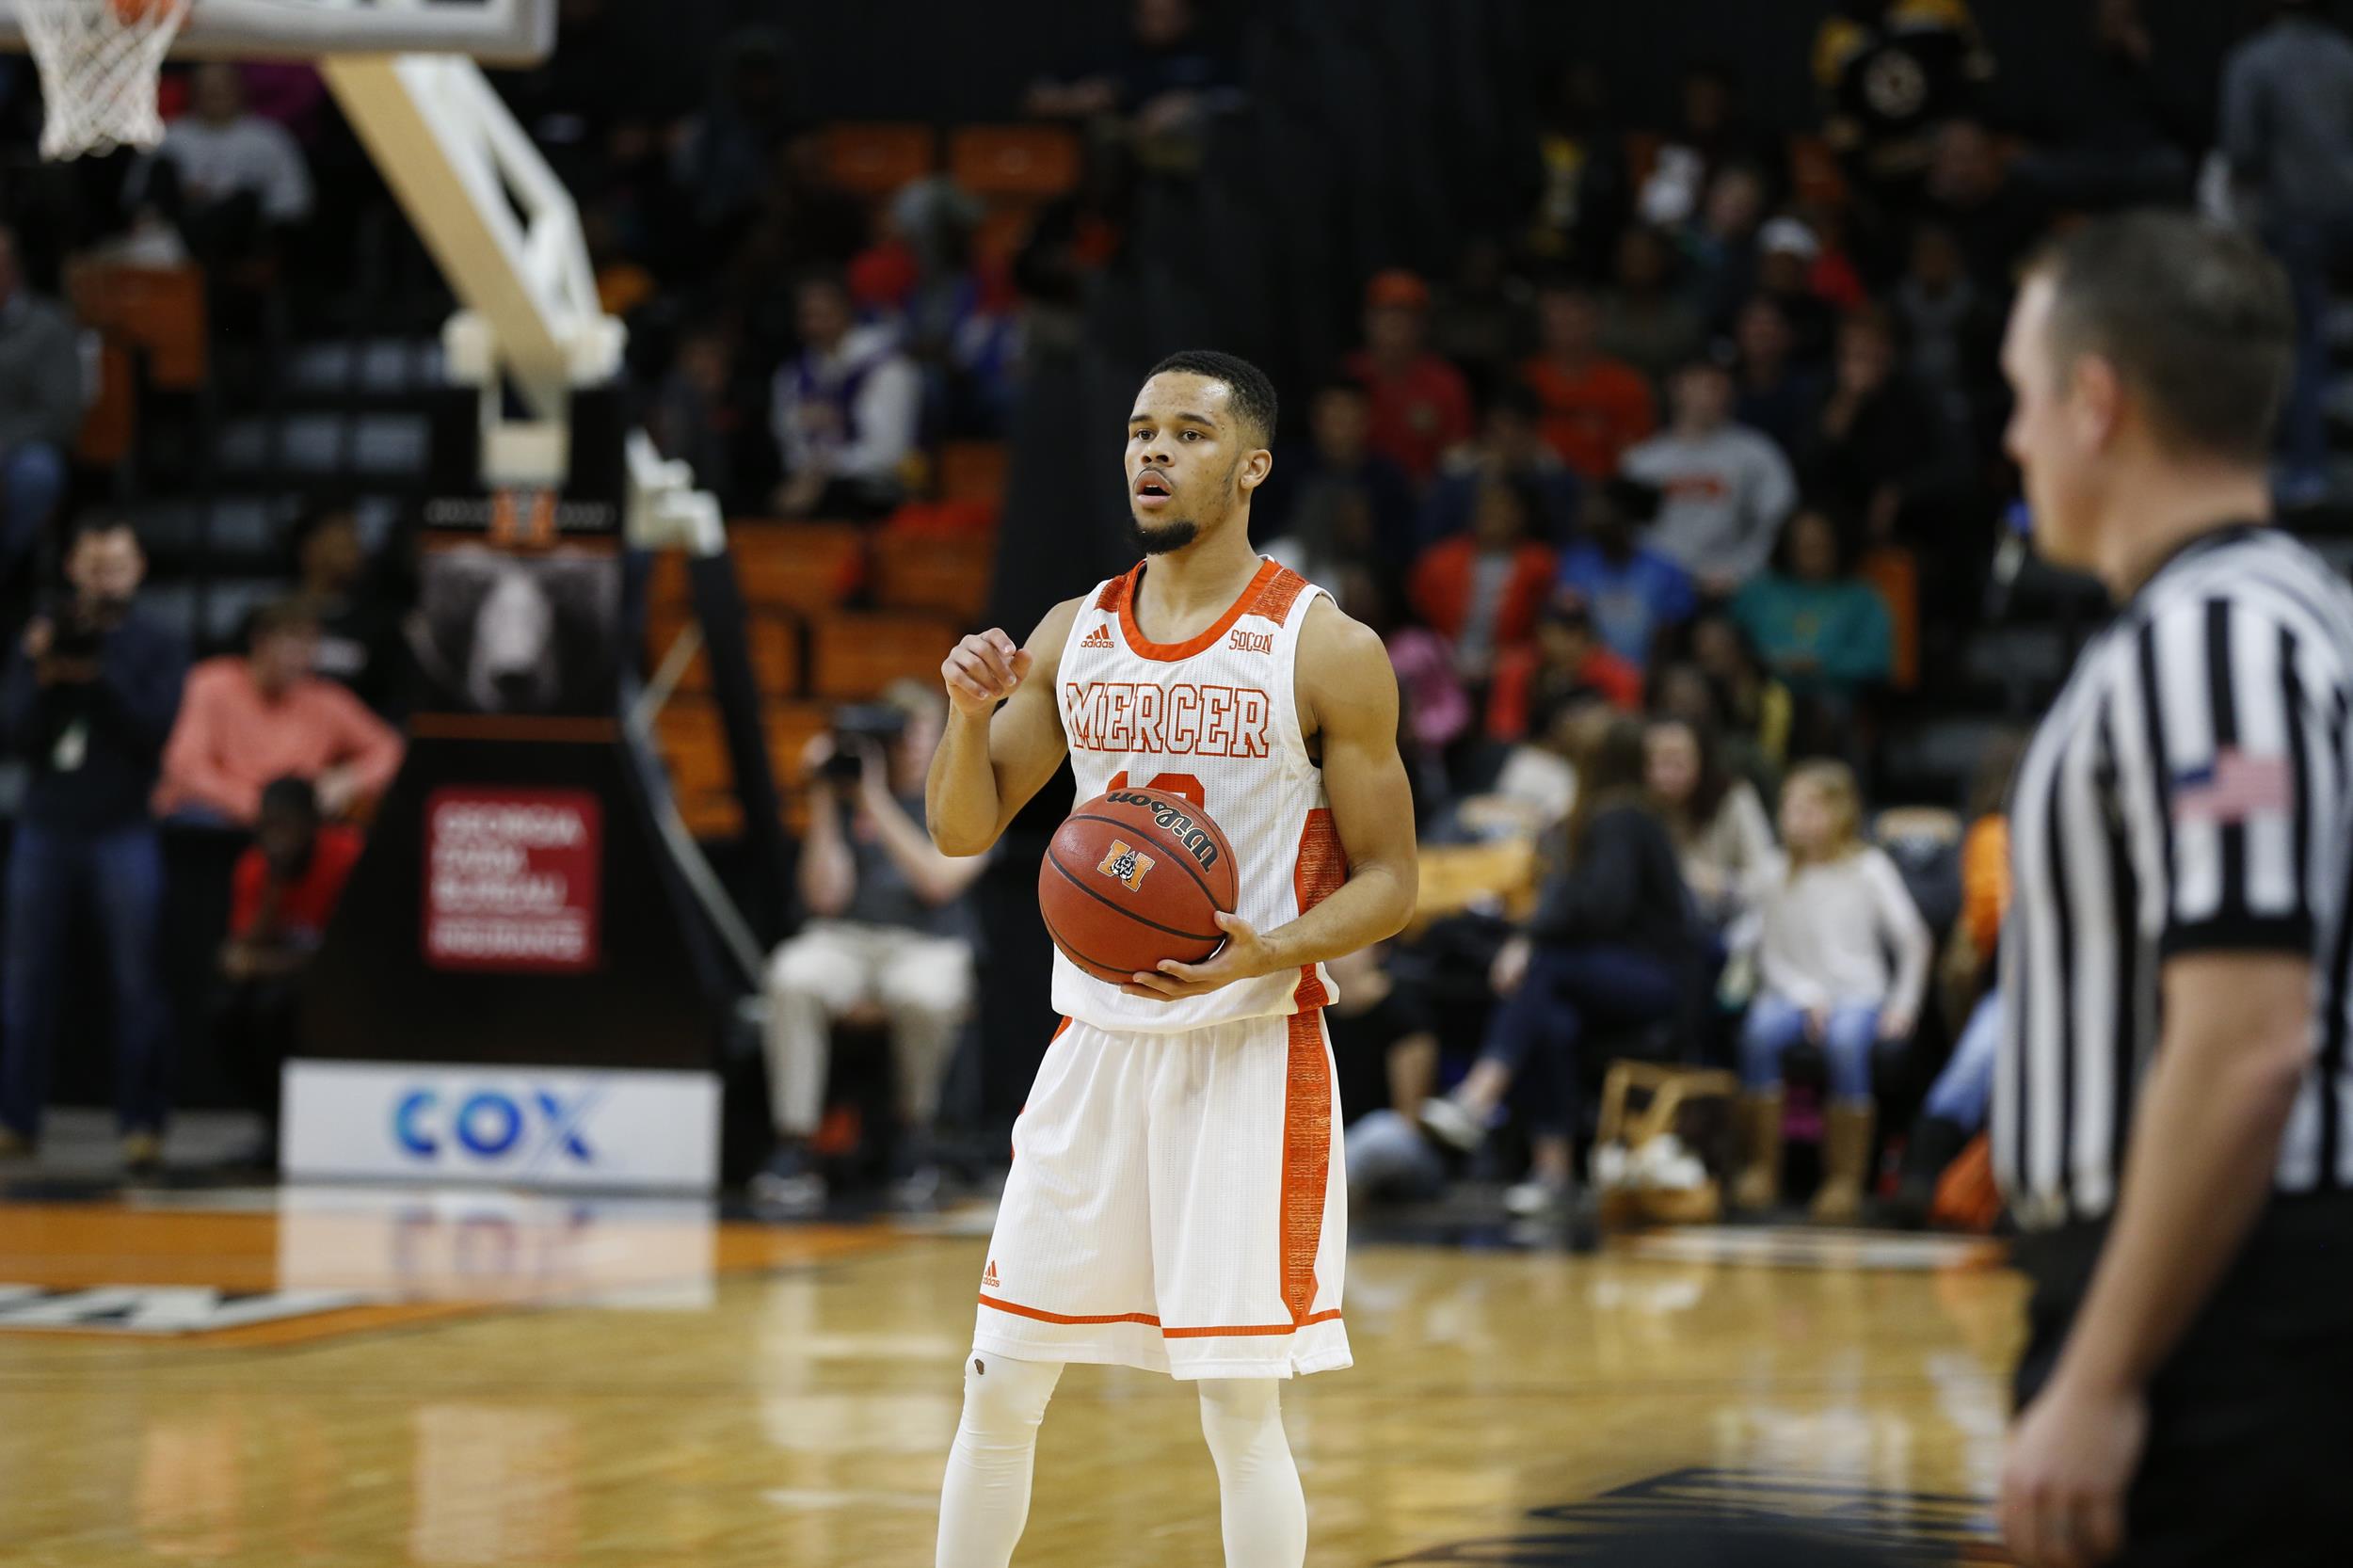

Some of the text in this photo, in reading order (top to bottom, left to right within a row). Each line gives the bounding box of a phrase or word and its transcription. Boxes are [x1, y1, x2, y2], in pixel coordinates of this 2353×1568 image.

[1080, 639, 1114, 648] adidas
[1228, 629, 1273, 655] SOCON
[1065, 681, 1270, 759] MERCER
[1106, 792, 1219, 873] Wilson
